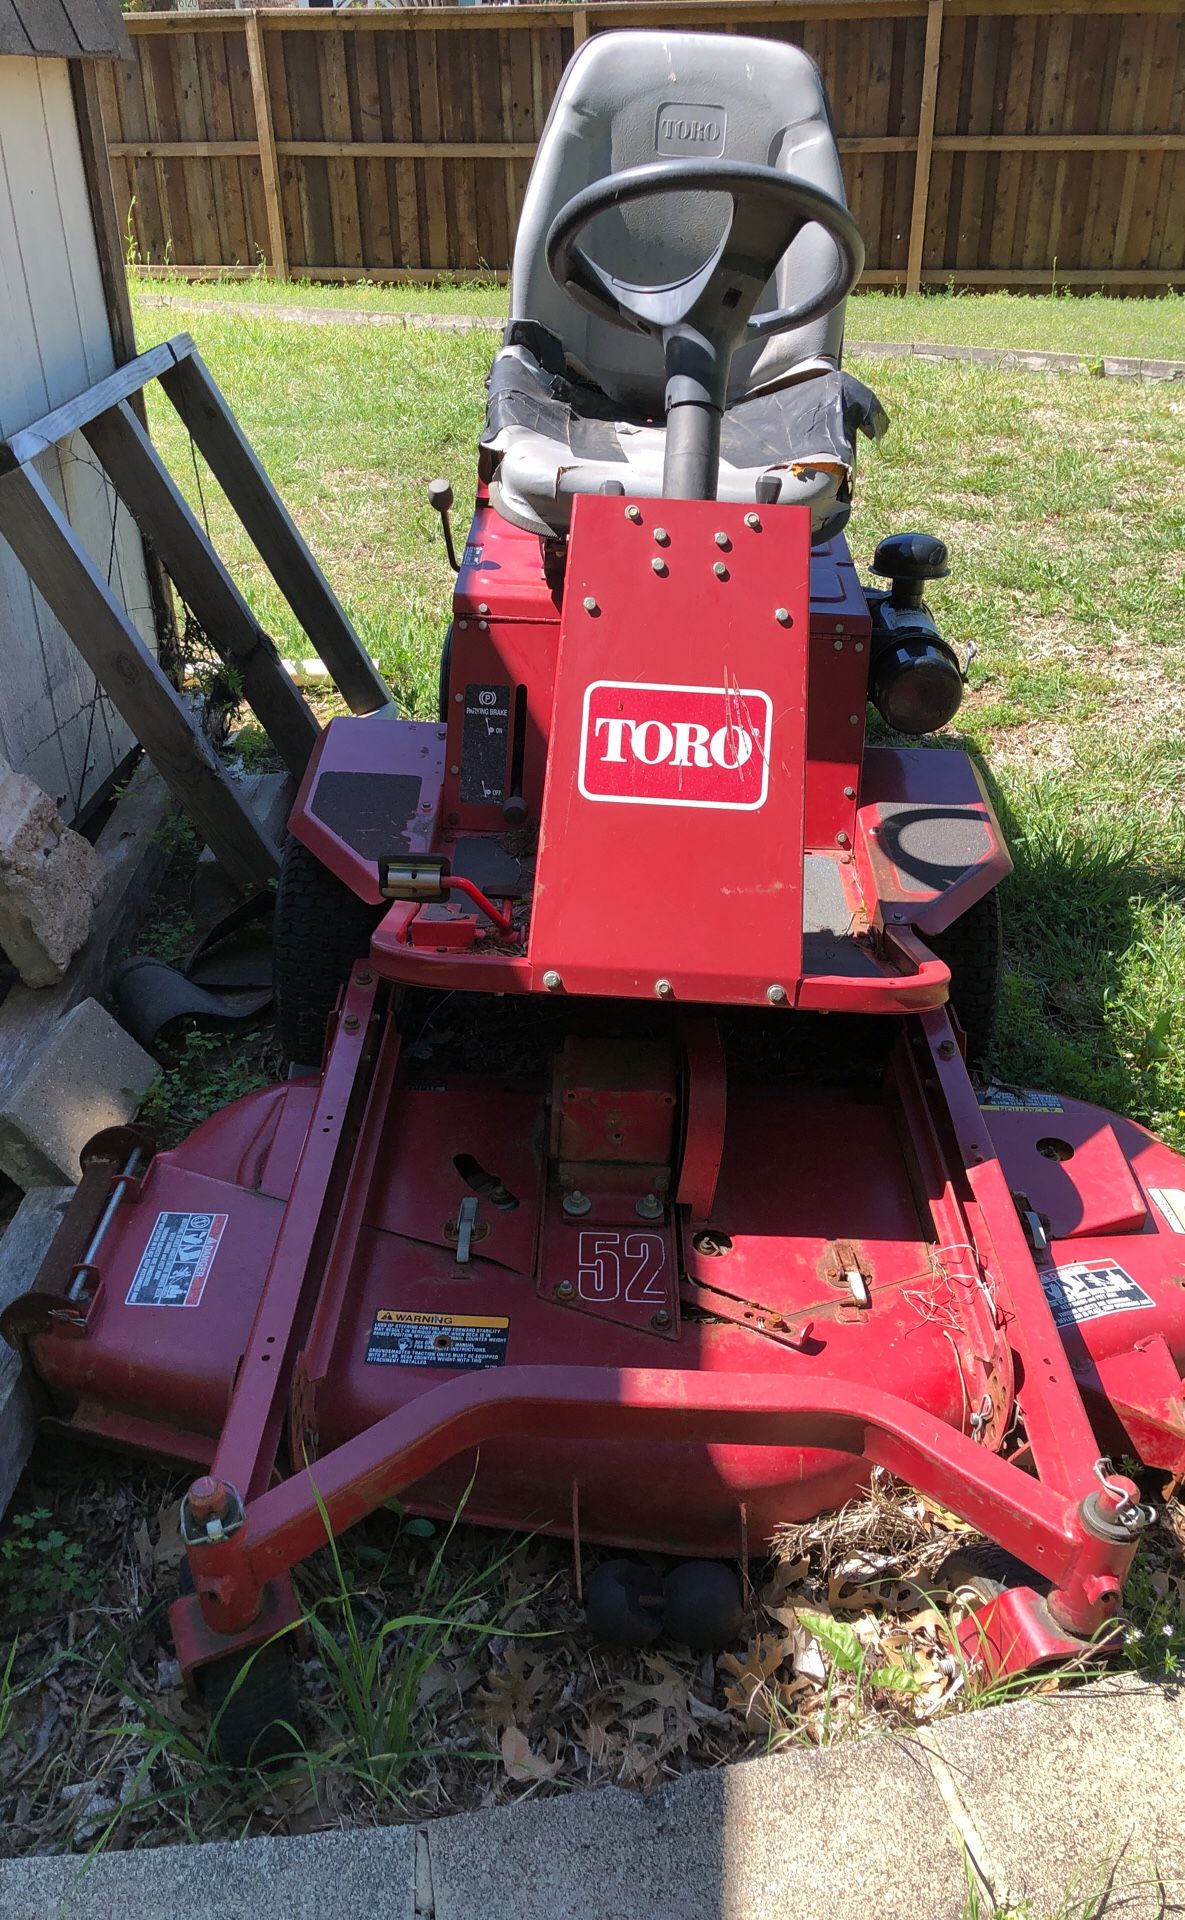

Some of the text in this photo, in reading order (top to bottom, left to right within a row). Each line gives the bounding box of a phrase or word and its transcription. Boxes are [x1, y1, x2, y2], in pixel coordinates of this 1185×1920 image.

[662, 119, 721, 142] TORO
[489, 709, 508, 717] BRAKE
[595, 717, 752, 769] TORO
[195, 1245, 213, 1277] DANGER
[579, 1232, 667, 1303] 52
[395, 1314, 453, 1324] WARNING
